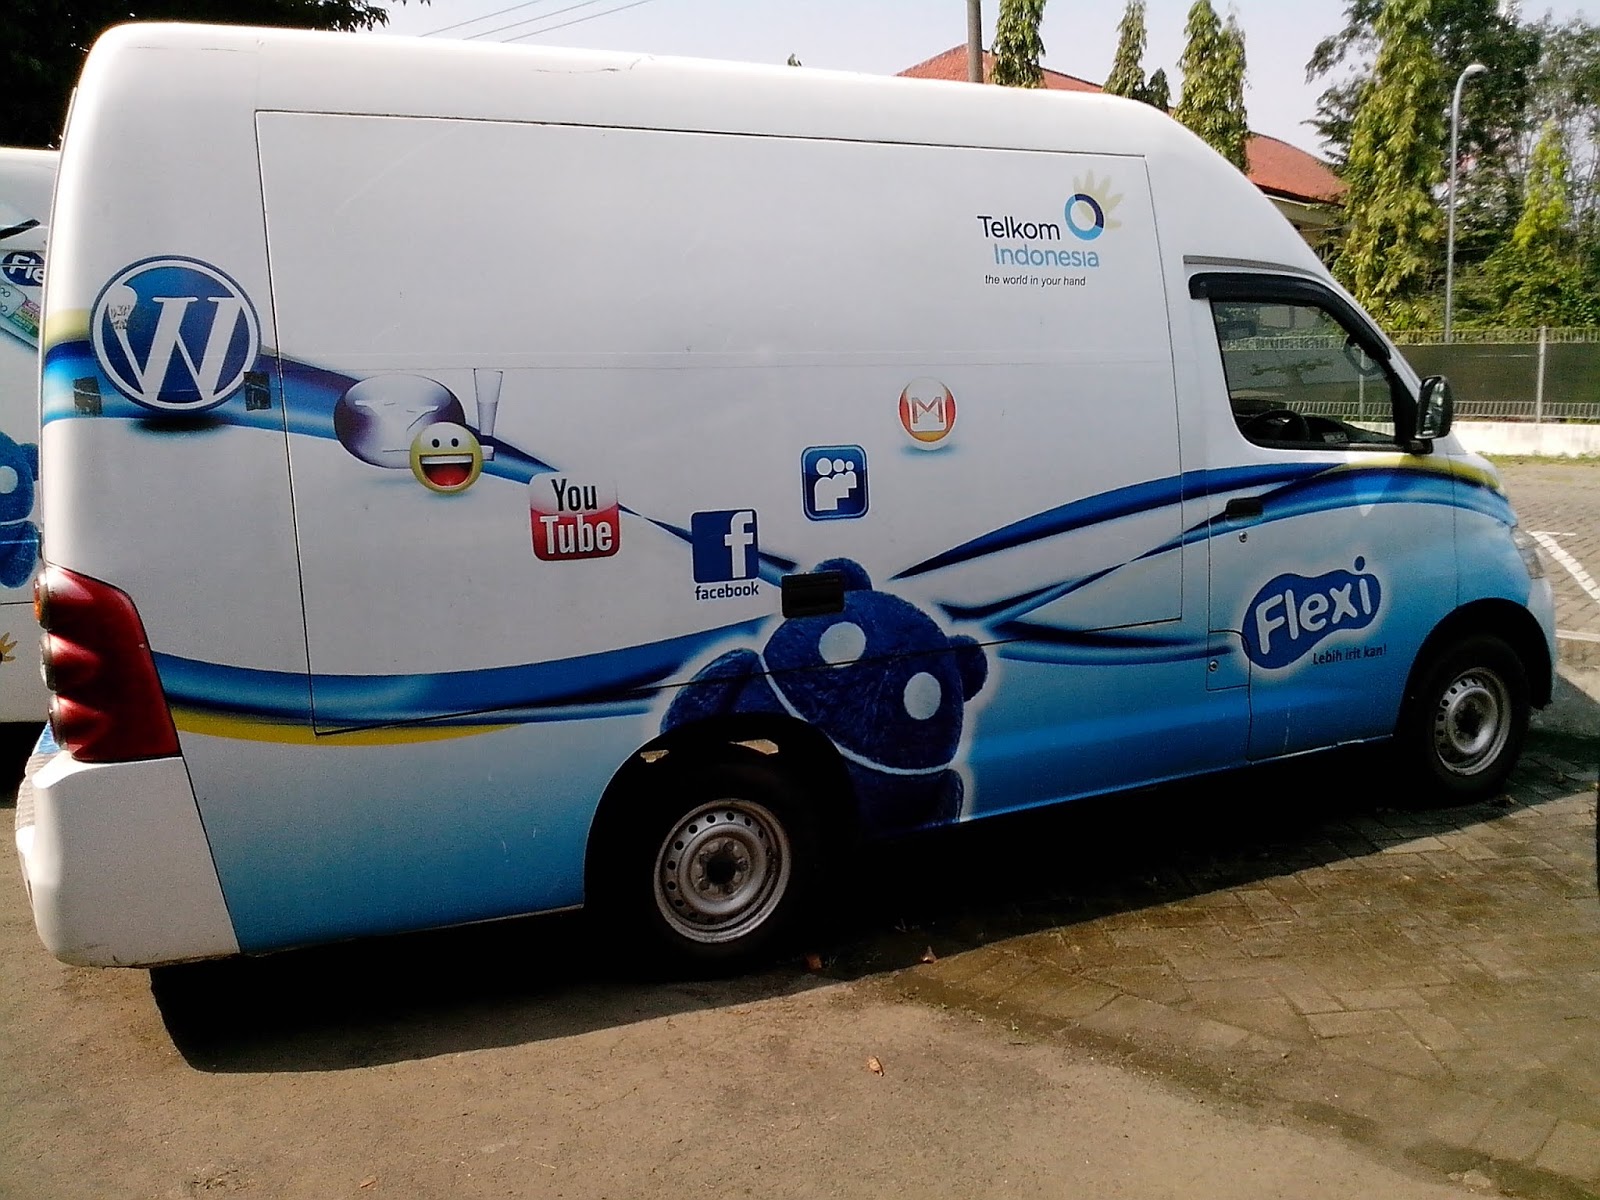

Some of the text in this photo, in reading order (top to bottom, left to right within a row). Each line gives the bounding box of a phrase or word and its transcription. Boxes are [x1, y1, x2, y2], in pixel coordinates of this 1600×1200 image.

[977, 215, 1061, 241] Telkom
[994, 243, 1100, 268] Indonesia
[985, 274, 1086, 288] the world in your hand
[103, 280, 247, 410] W
[551, 478, 598, 512] You
[540, 513, 613, 555] Tube
[724, 511, 754, 579] f
[695, 581, 759, 601] facebook
[1255, 555, 1372, 656] Flexi
[1313, 647, 1342, 665] Lebih
[1363, 642, 1388, 659] kan!
